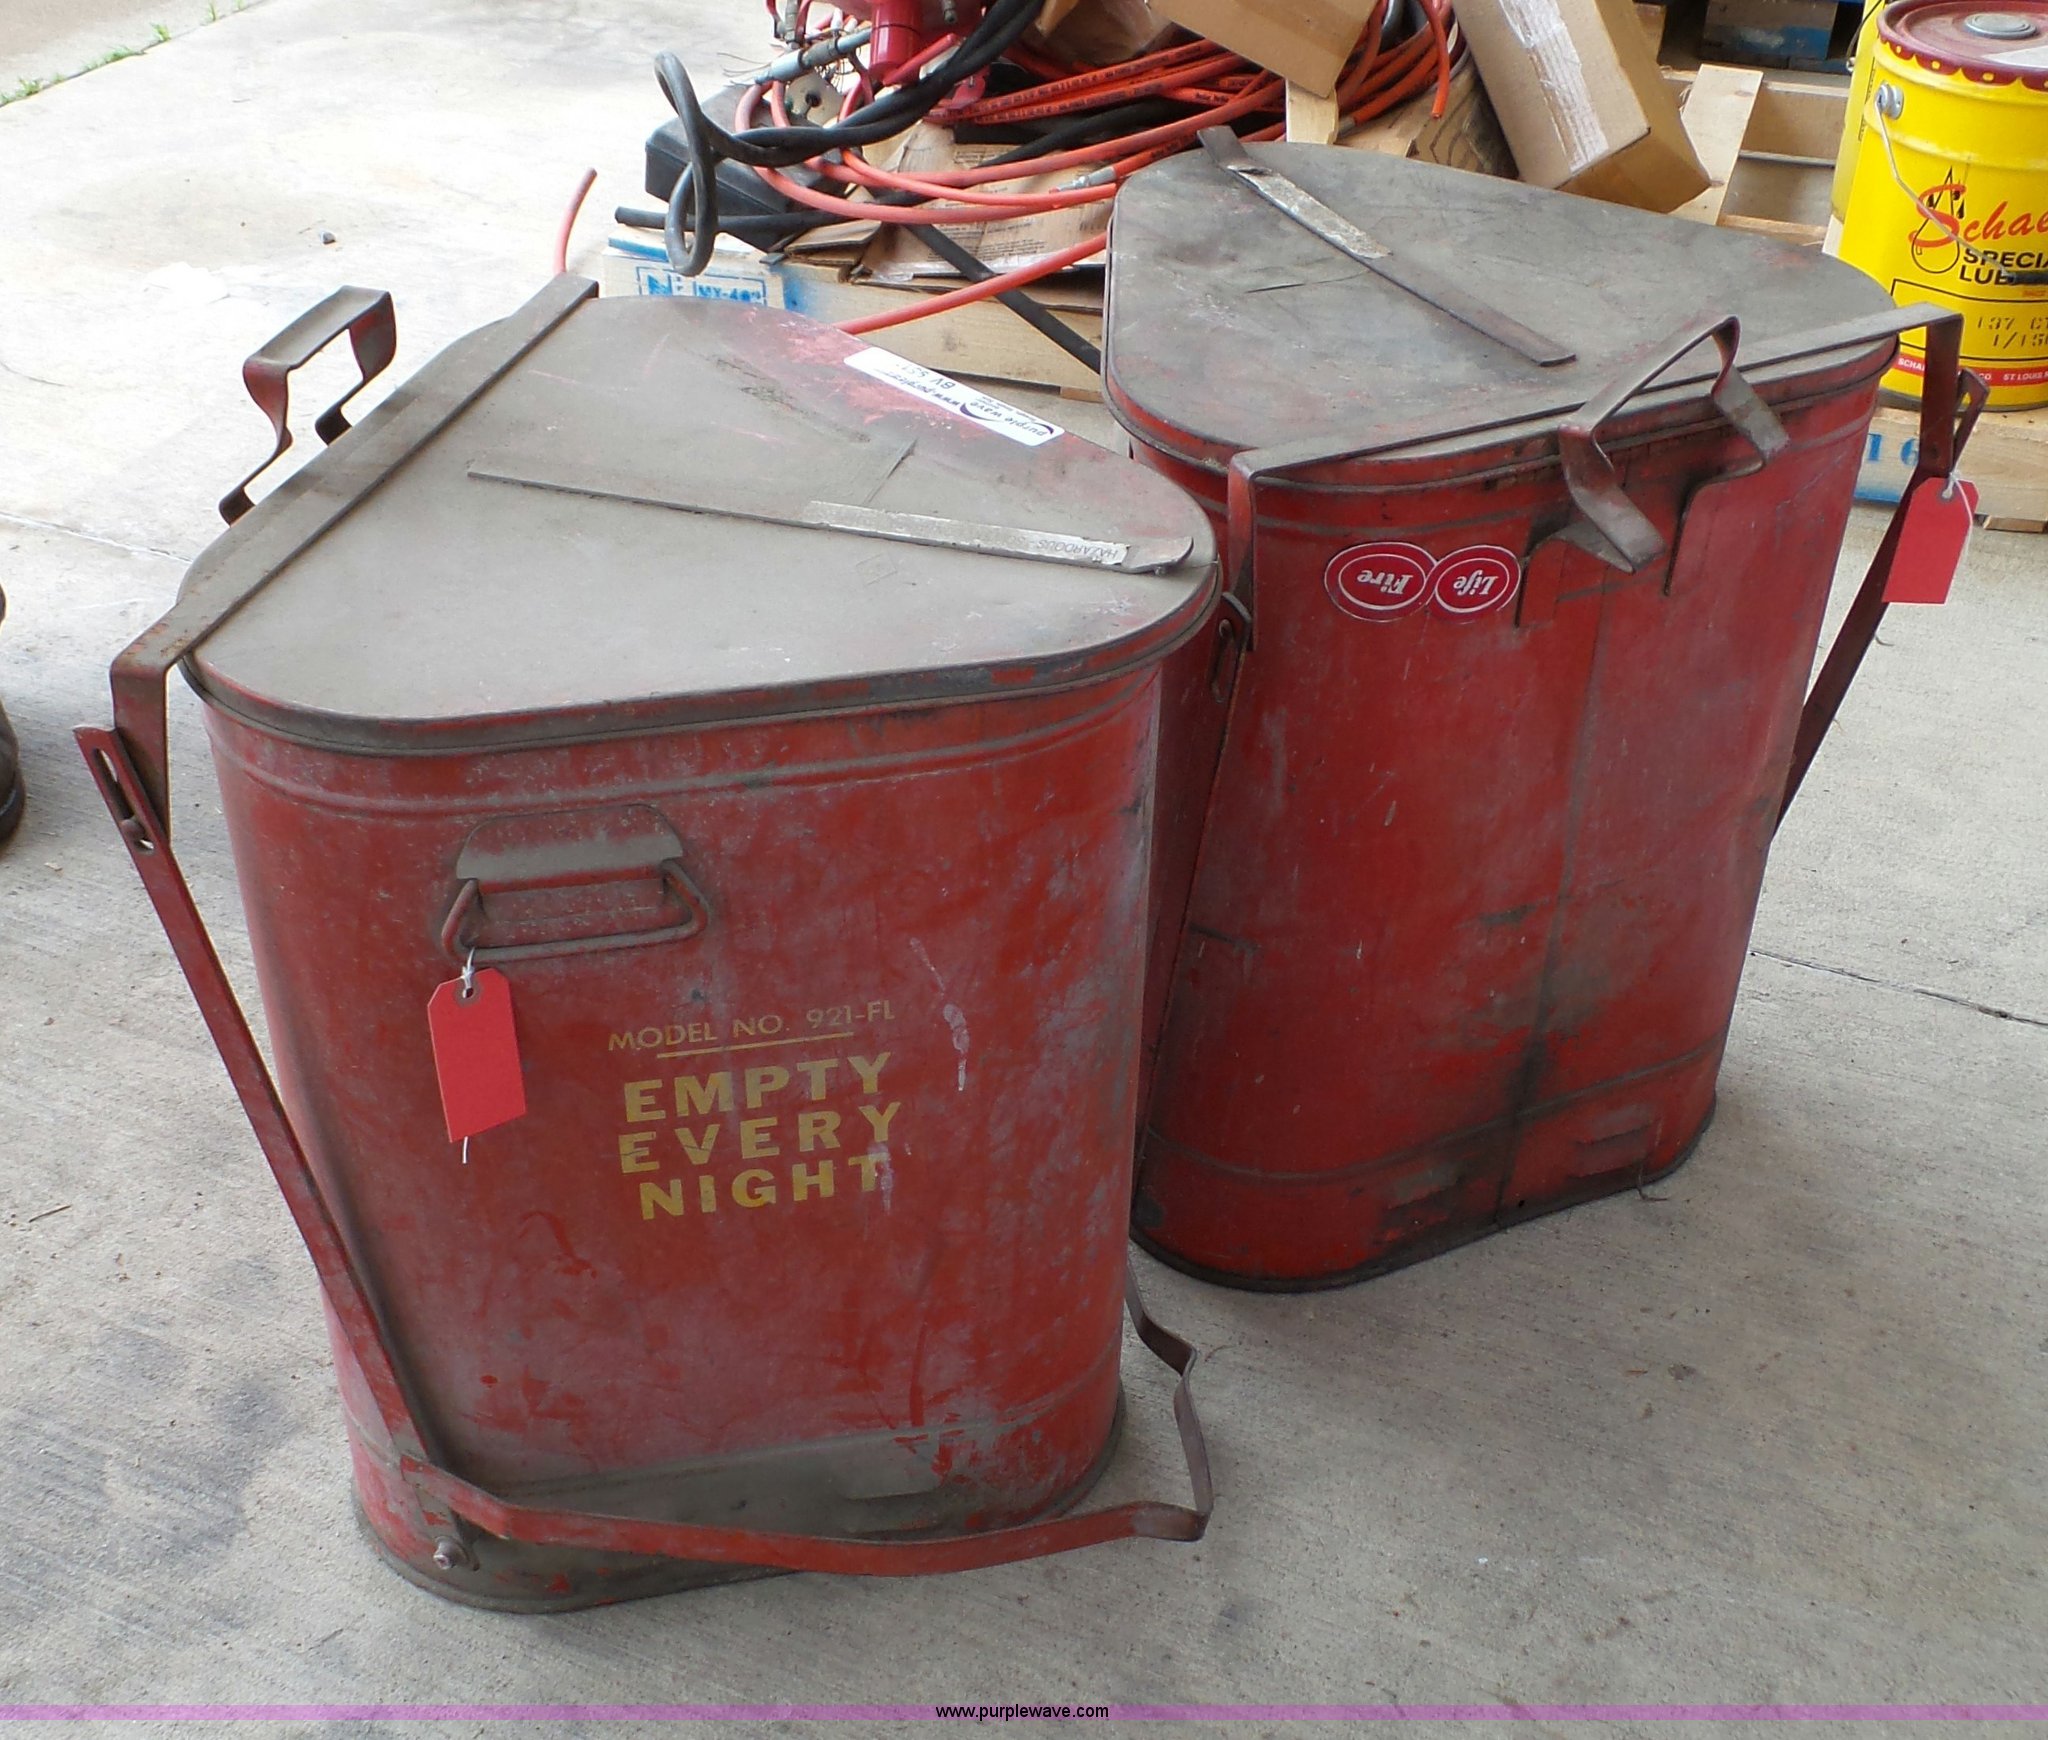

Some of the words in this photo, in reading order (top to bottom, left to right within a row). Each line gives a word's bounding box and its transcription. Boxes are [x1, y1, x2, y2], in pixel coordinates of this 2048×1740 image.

[969, 401, 1002, 418] wave
[1004, 416, 1048, 436] purple
[1357, 569, 1414, 595] Fire
[1453, 569, 1499, 596] Life
[608, 1022, 718, 1051] MODEL
[732, 1014, 790, 1038] NO.
[805, 999, 895, 1029] 921-FL
[623, 1051, 891, 1123] EMPTY
[618, 1101, 901, 1174] EVERY
[639, 1151, 889, 1220] NIGHT
